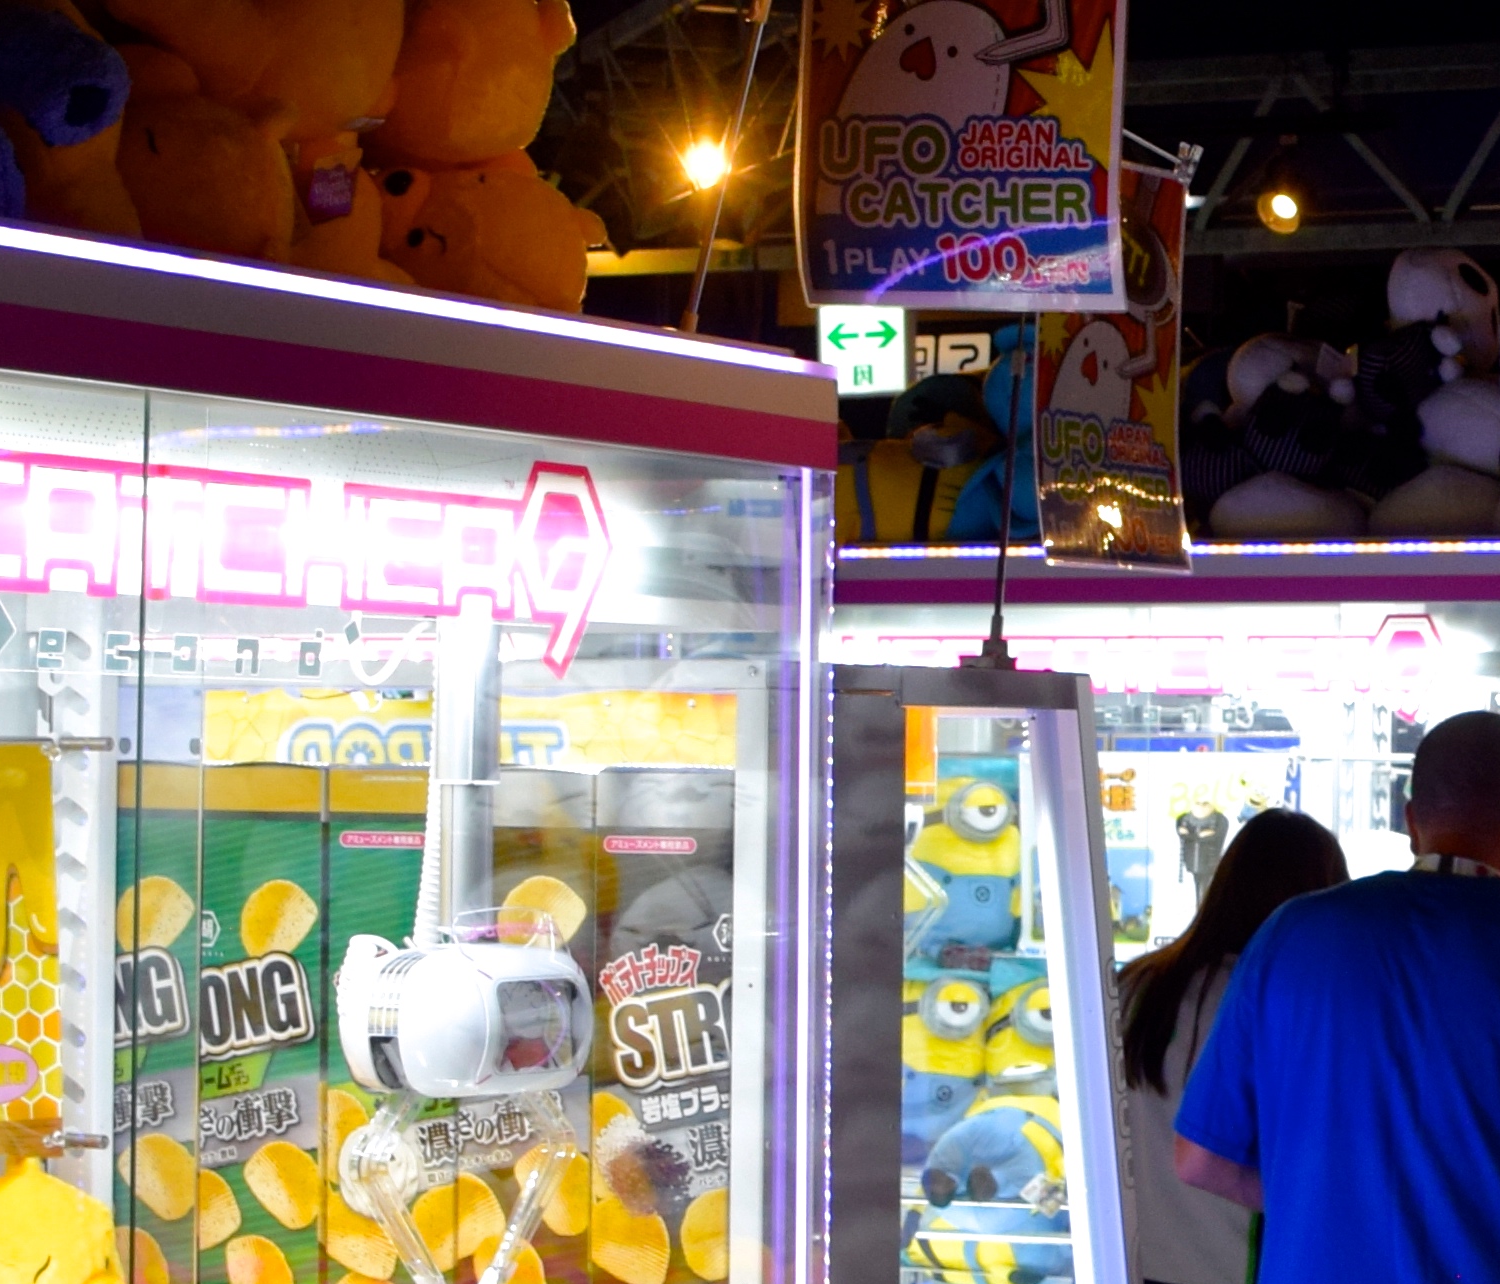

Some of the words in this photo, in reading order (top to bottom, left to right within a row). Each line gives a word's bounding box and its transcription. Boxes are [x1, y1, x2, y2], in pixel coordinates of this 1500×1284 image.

[821, 120, 947, 179] UFO
[959, 121, 1055, 147] JAPAN
[959, 146, 1090, 170] ORIGINAL
[847, 182, 1091, 227] CATCHER
[824, 240, 839, 274] 1
[844, 248, 931, 275] PLAY
[938, 234, 1026, 283] 100
[1042, 413, 1104, 465] UFO
[599, 945, 702, 1006] ポテトチップス
[612, 994, 731, 1084] STR
